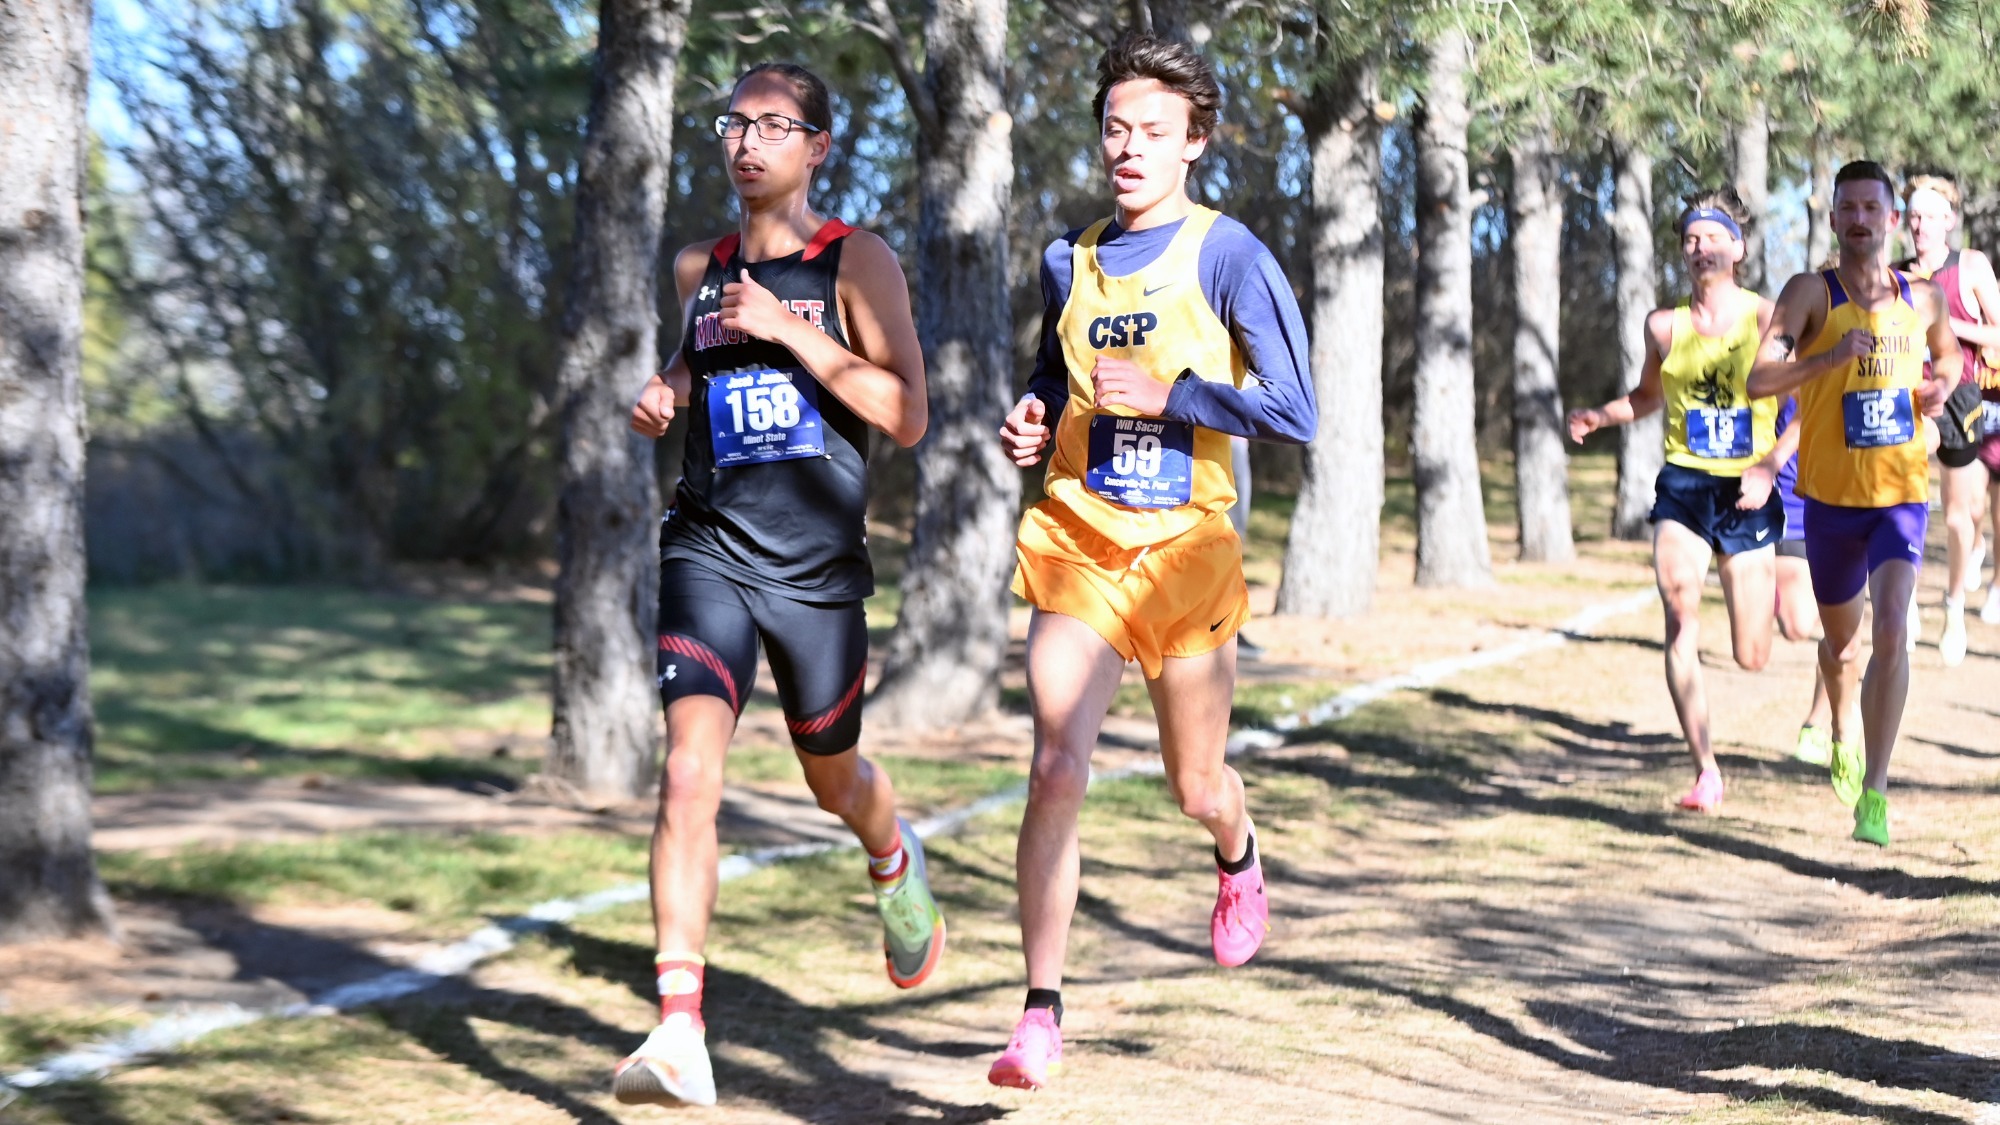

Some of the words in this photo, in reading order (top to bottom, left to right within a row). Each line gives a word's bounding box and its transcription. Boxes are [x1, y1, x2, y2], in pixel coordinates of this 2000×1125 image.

[1088, 312, 1158, 350] CSP
[1842, 334, 1910, 353] ESOTA
[725, 384, 800, 433] 158
[1863, 398, 1897, 429] 82
[743, 434, 764, 445] Minot
[765, 432, 787, 443] State
[1115, 419, 1134, 431] Will
[1135, 420, 1165, 434] Sacay
[1112, 432, 1162, 478] 59
